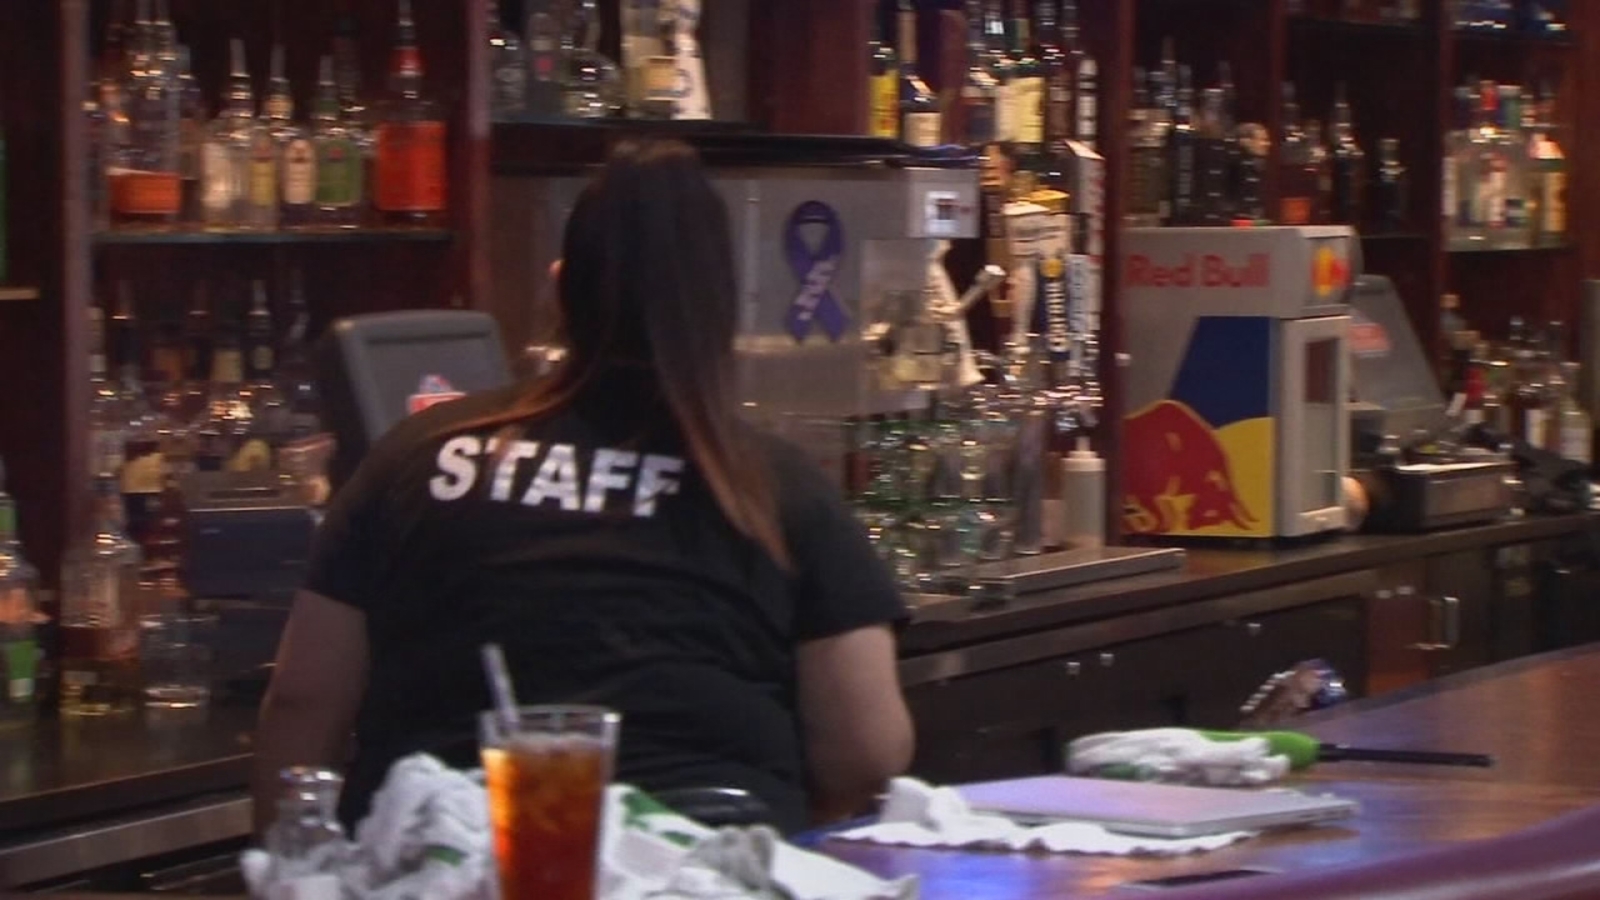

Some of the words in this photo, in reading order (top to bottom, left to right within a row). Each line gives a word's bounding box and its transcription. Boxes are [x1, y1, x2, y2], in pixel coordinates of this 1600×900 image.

[1126, 254, 1194, 287] Red
[1203, 254, 1270, 287] Bull
[429, 435, 684, 517] STAFF
